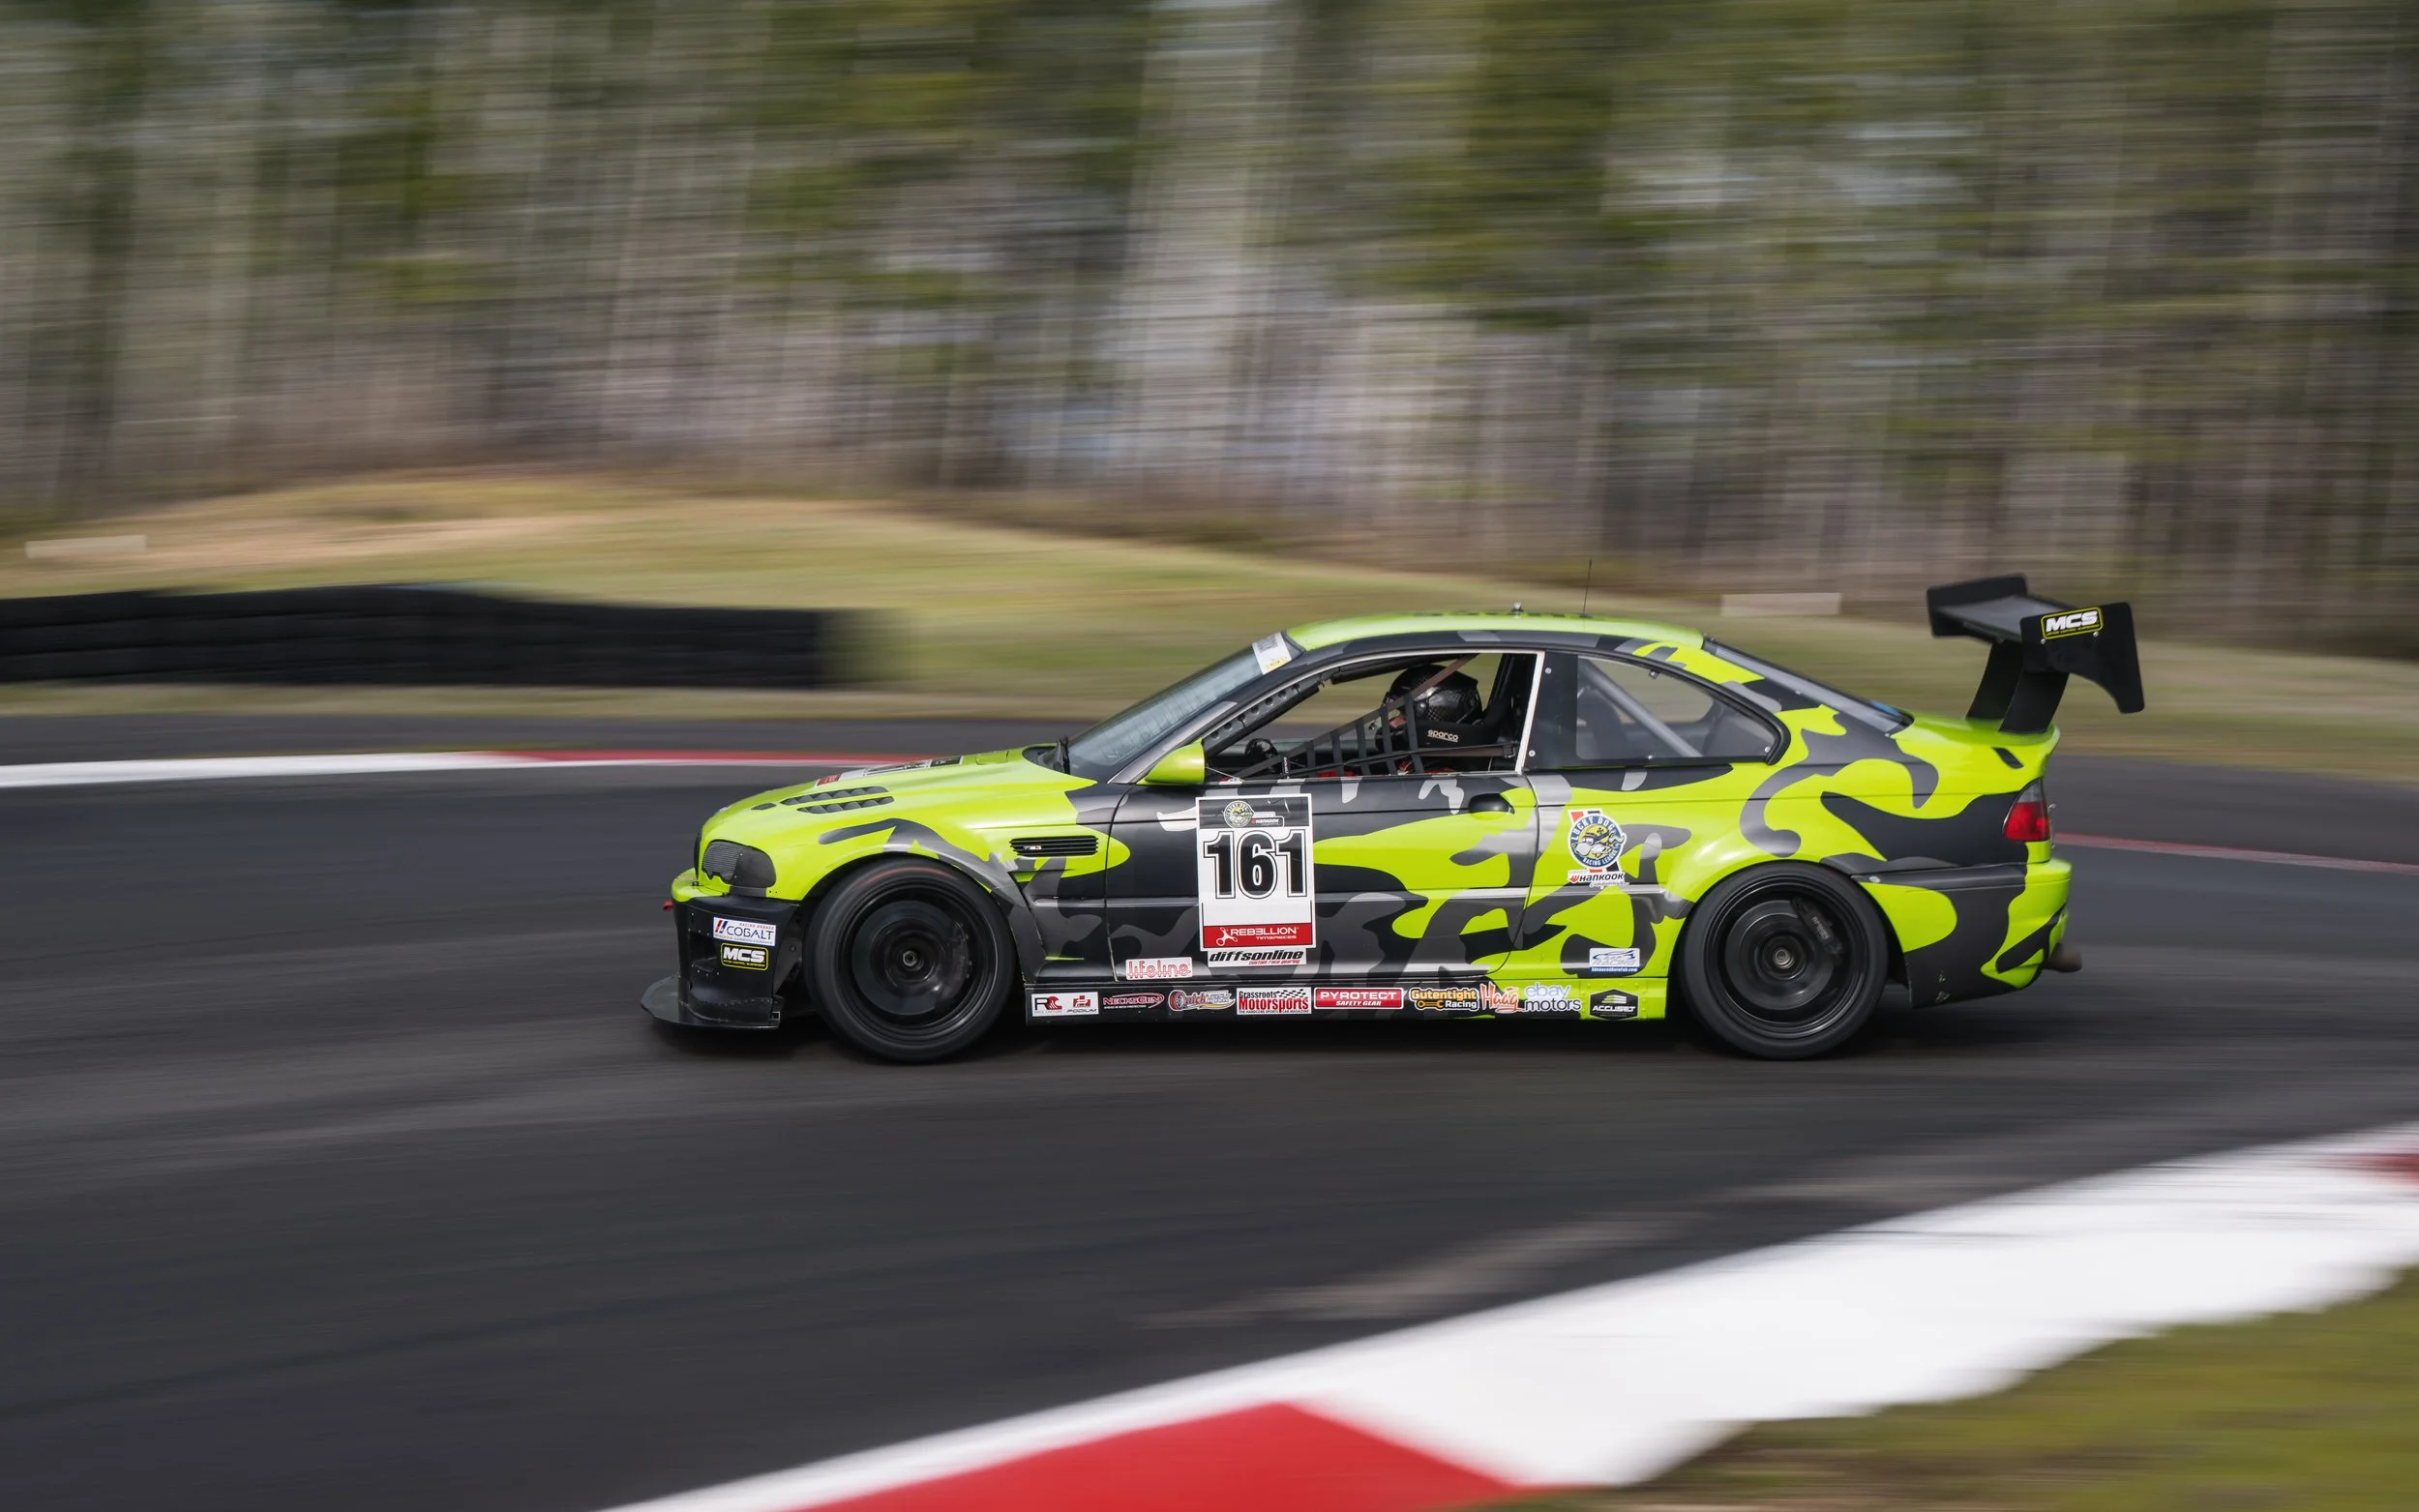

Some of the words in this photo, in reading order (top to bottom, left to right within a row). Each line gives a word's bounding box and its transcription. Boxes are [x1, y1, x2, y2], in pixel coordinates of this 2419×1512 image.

[2046, 610, 2098, 633] MCS
[1427, 729, 1459, 742] sparco
[1570, 816, 1594, 841] LUCKY
[1598, 816, 1616, 830] DOG
[1203, 829, 1308, 900] 161
[1582, 857, 1601, 866] RACING
[1601, 849, 1619, 865] LEAGUE
[726, 926, 774, 940] COBALT
[1230, 927, 1297, 936] REBELLION
[723, 947, 765, 964] MCS
[1209, 949, 1304, 963] diffsonline
[1128, 960, 1191, 979] lifeline
[1320, 992, 1397, 1000] PYROTECT
[1411, 990, 1478, 1000] Gutentight
[1479, 981, 1519, 1012] Haag
[1525, 982, 1570, 999] ebay
[1239, 997, 1309, 1013] Motorsports
[1445, 1000, 1478, 1009] Racing
[1525, 997, 1581, 1011] motors
